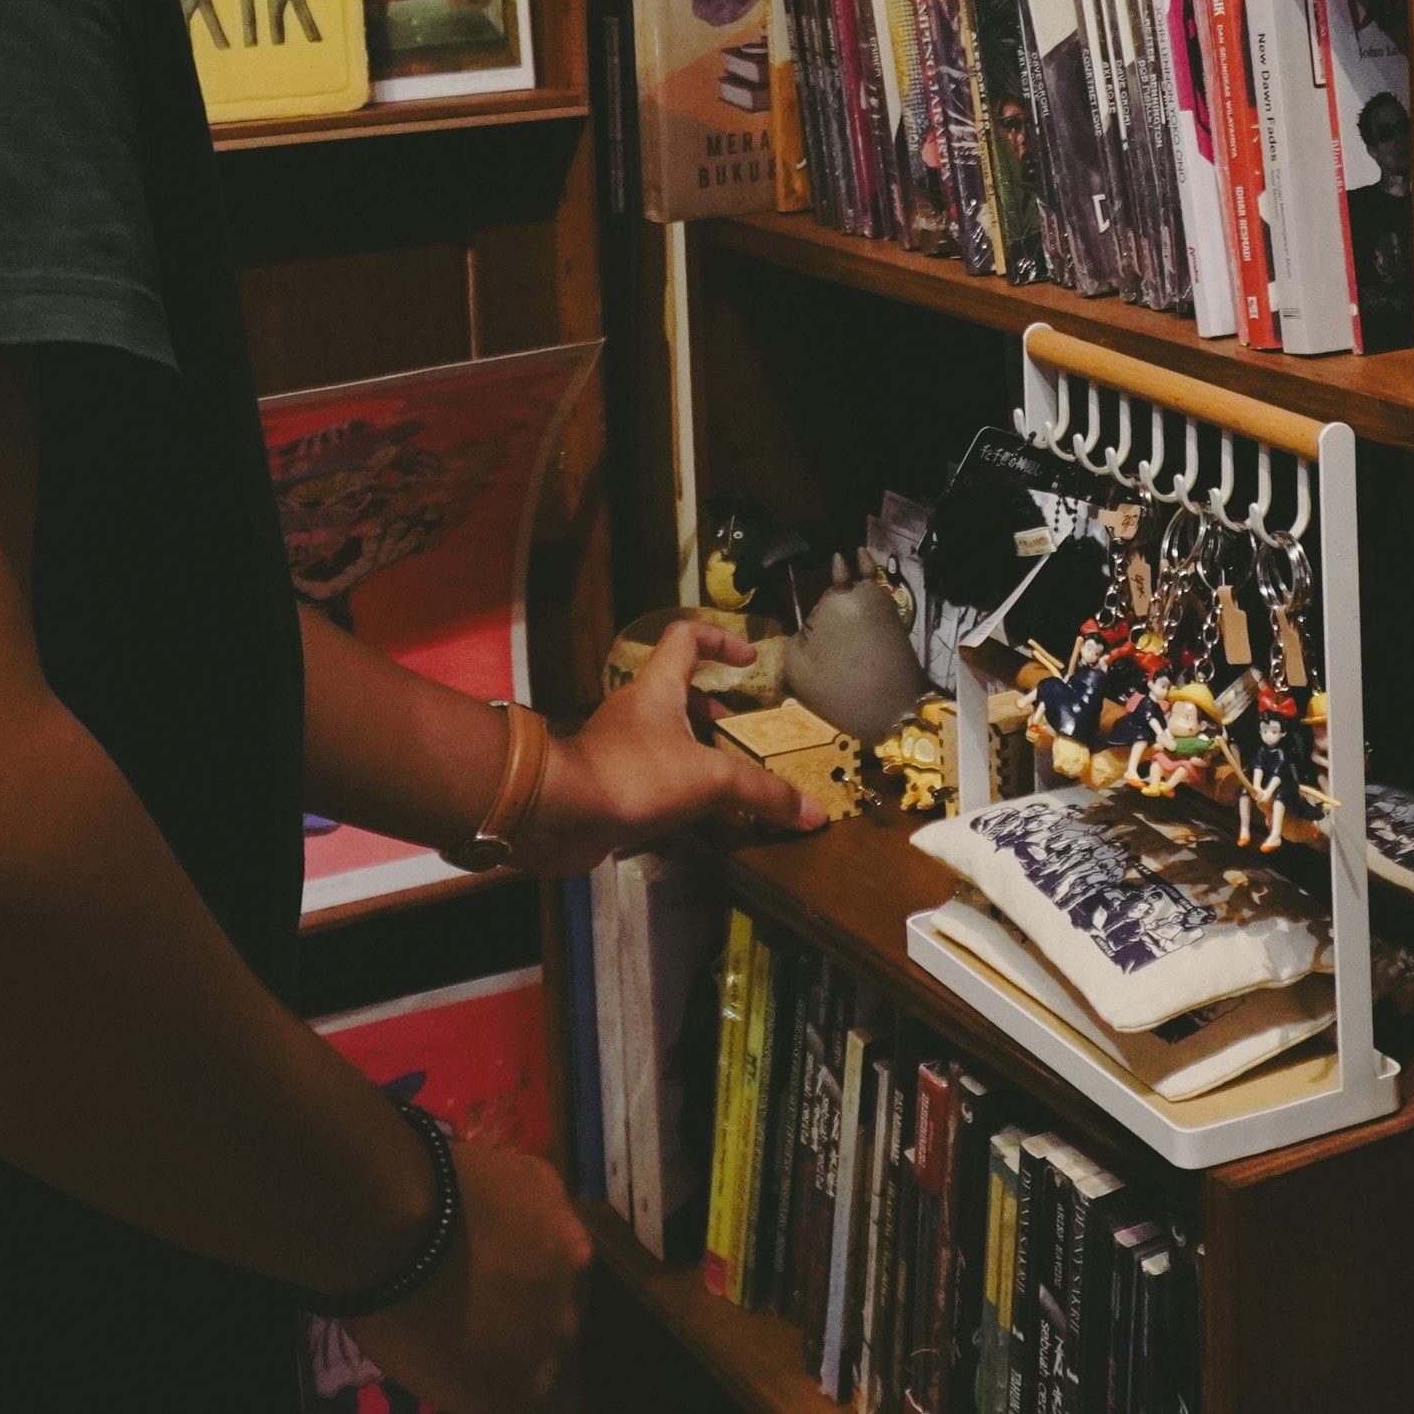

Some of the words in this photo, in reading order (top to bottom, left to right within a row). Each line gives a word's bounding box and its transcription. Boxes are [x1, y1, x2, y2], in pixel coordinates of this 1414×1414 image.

[1160, 41, 1174, 99] LENNON
[1256, 31, 1269, 67] New
[1259, 70, 1274, 113] Dawn
[1167, 102, 1180, 138] YOKO
[1265, 116, 1279, 164] Fades
[1172, 140, 1187, 184] ONO
[1238, 222, 1252, 263] RESMADI
